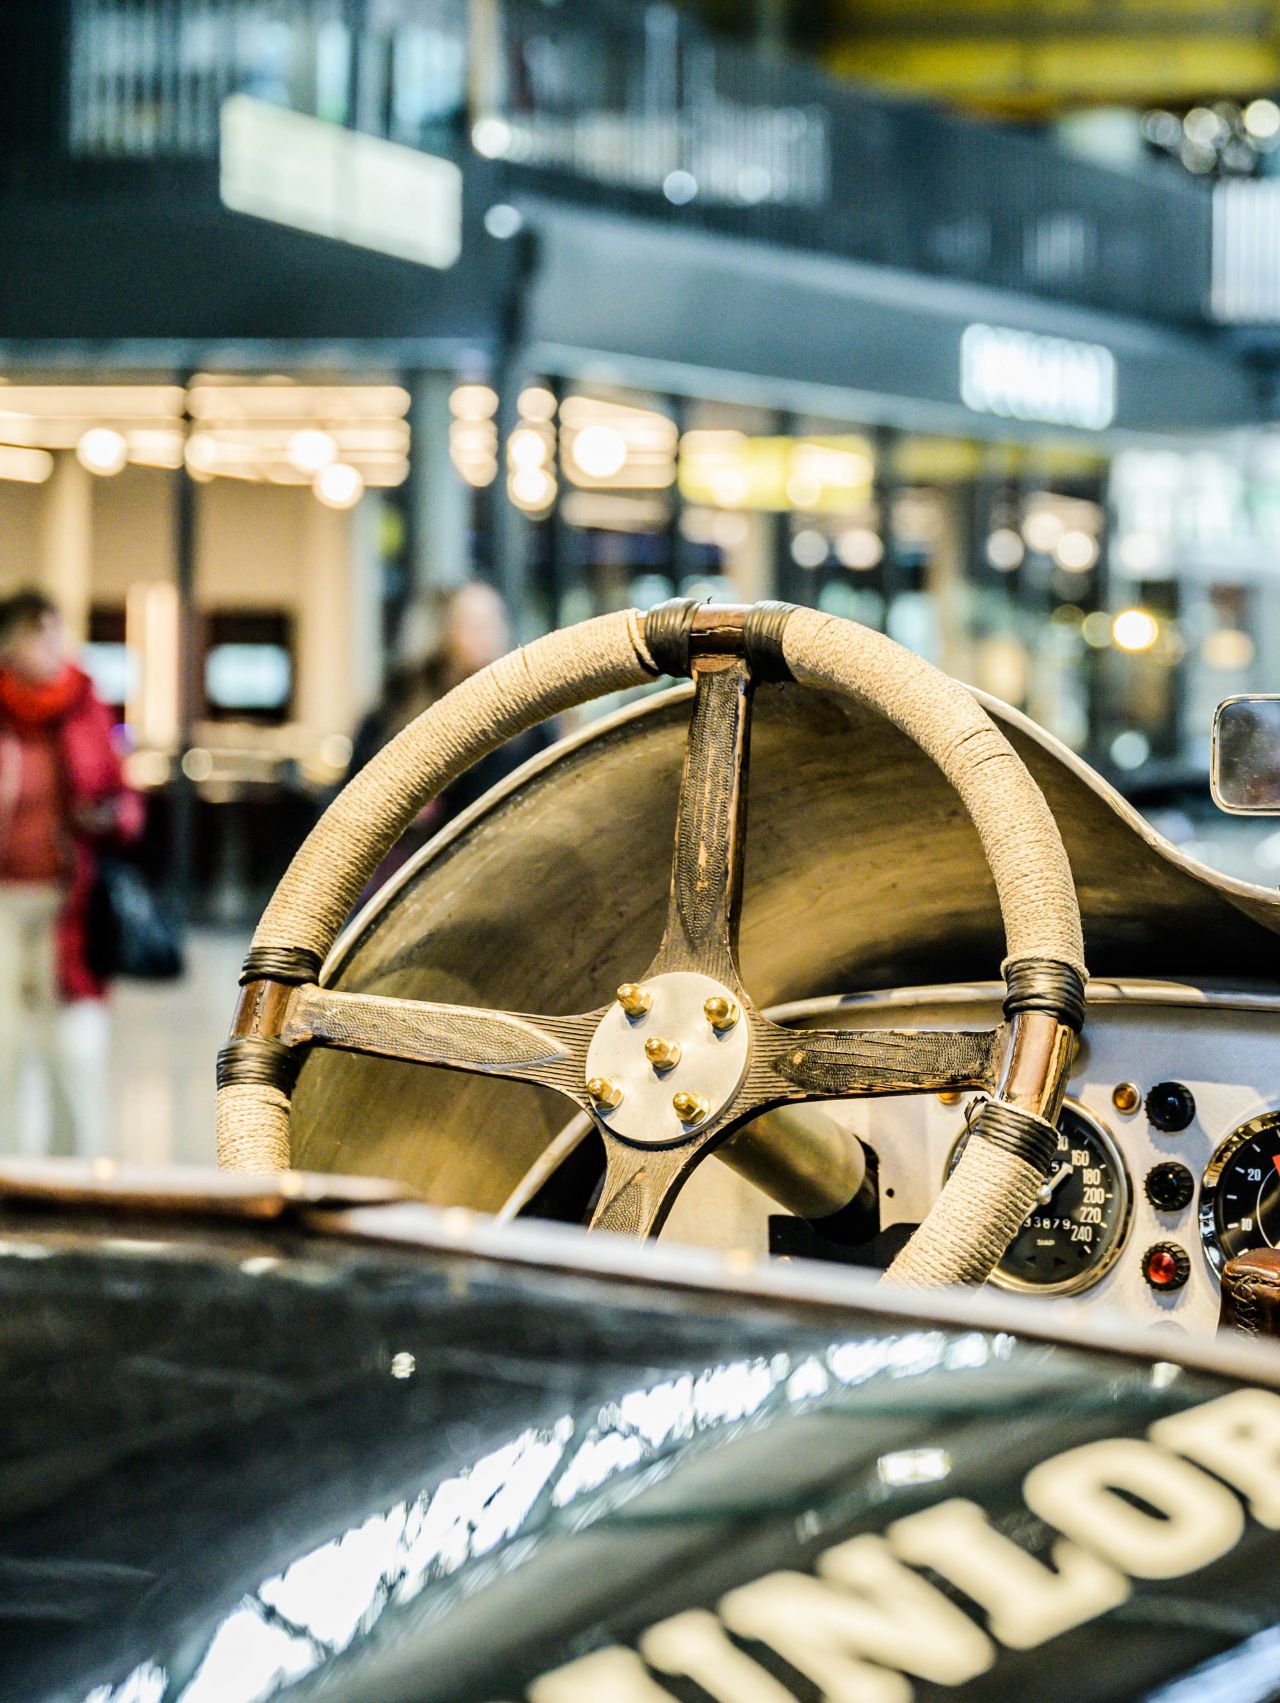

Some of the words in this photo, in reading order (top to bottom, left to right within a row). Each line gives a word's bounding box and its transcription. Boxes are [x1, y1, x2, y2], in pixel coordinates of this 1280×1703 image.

[1051, 1161, 1060, 1172] 5
[1071, 1150, 1089, 1167] 160
[1083, 1168, 1101, 1185] 180
[1247, 1168, 1261, 1181] 20
[1083, 1187, 1105, 1204] 200
[1080, 1207, 1101, 1224] 220
[1241, 1218, 1253, 1231] 10
[1071, 1225, 1092, 1242] 240
